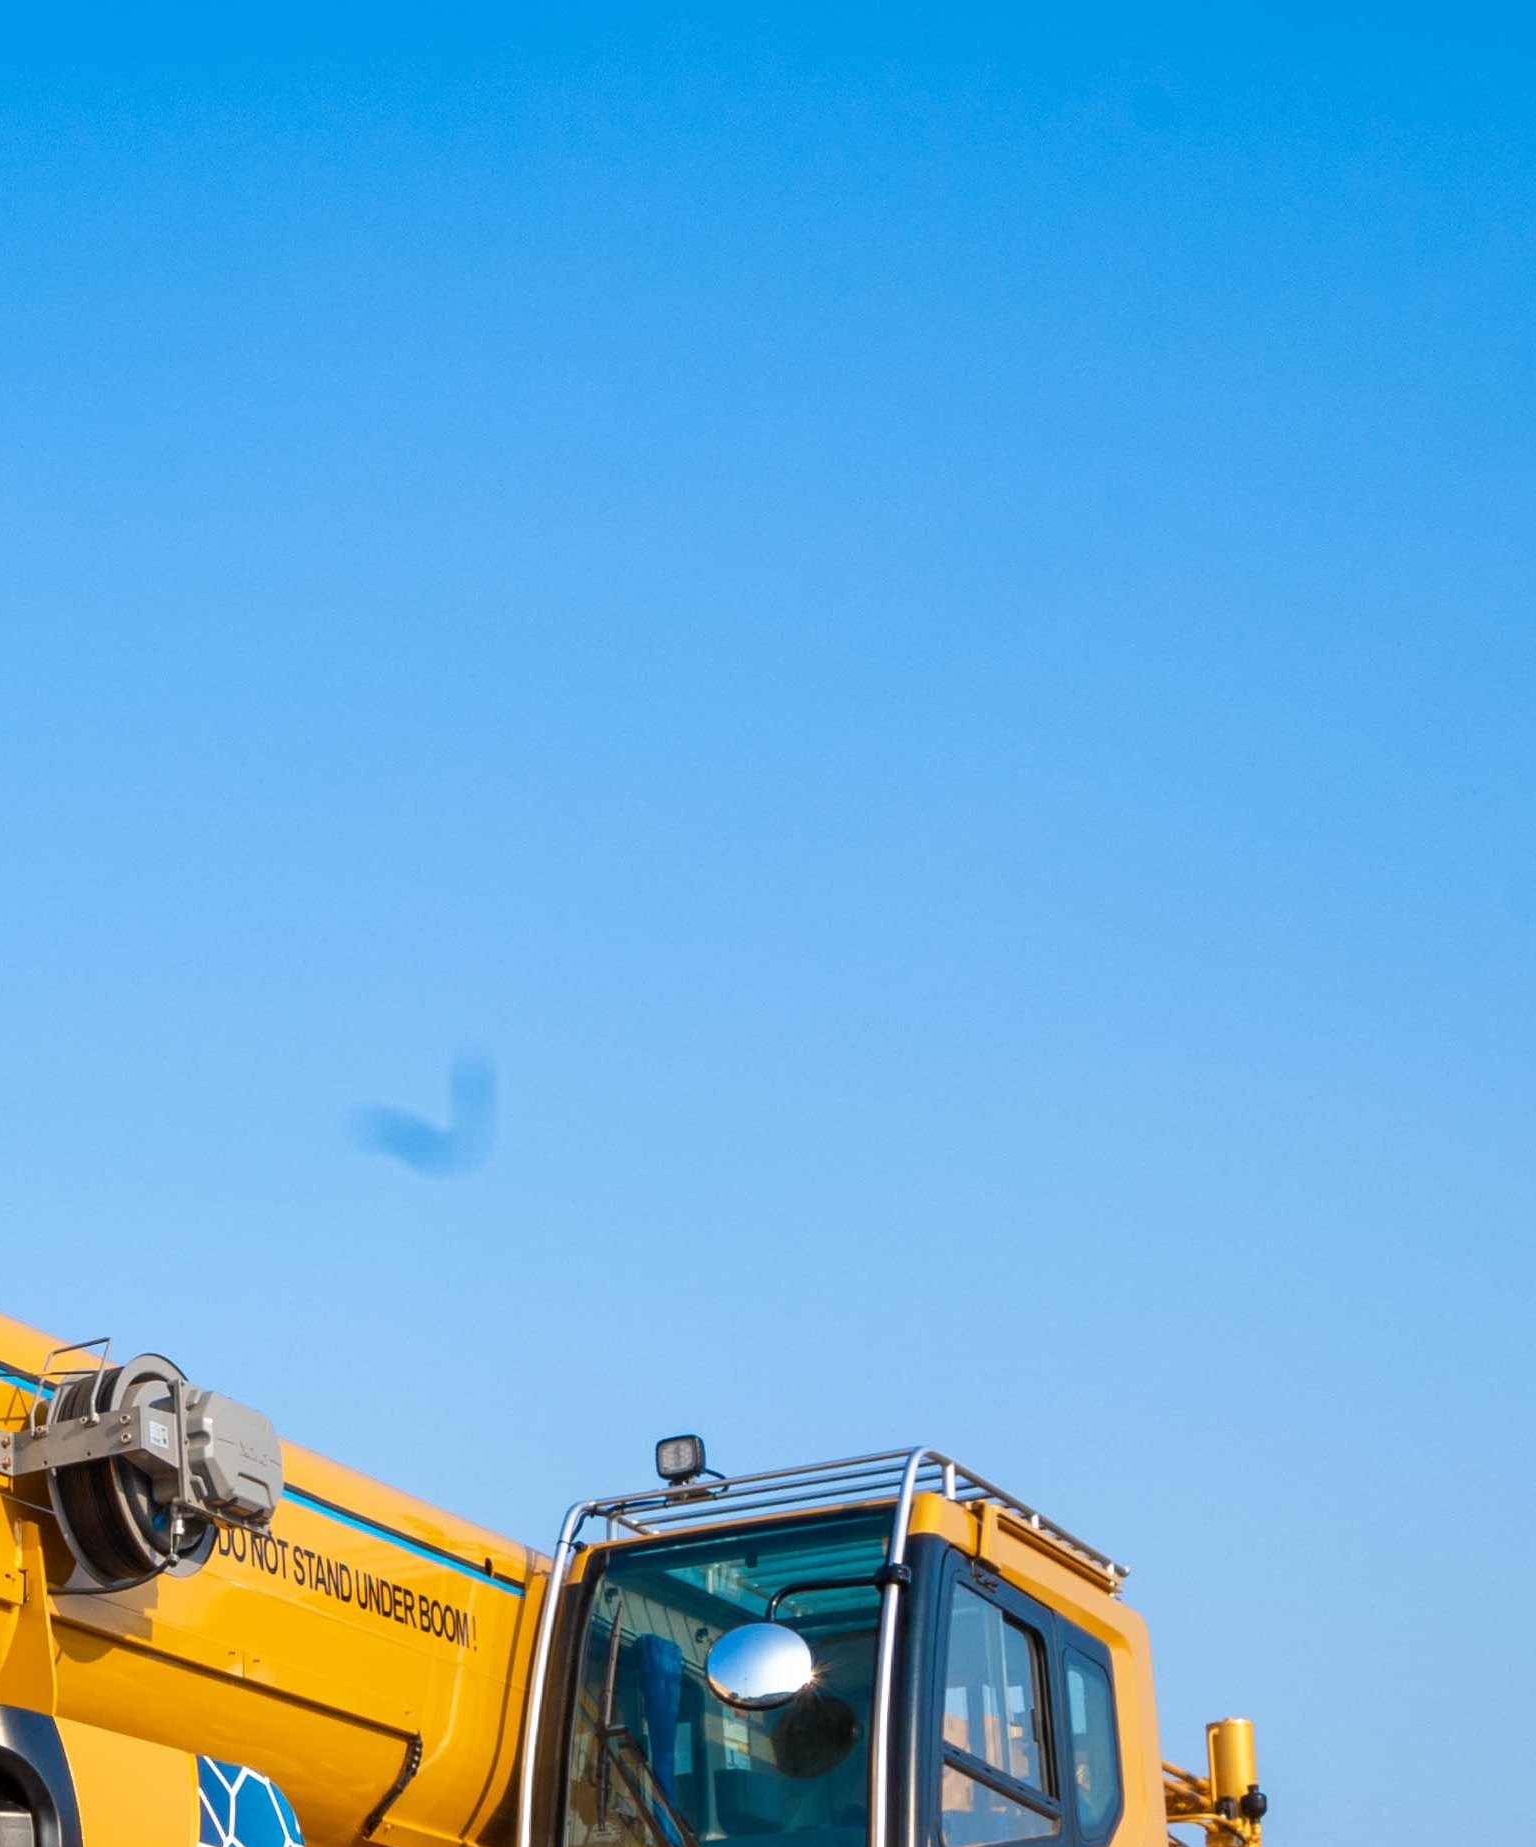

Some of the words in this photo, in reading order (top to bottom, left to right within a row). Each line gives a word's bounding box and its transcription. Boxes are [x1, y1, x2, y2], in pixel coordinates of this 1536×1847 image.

[250, 1531, 289, 1580] NOT
[294, 1545, 353, 1602] STAND
[355, 1569, 417, 1629] UNDER
[419, 1594, 469, 1648] BOOM
